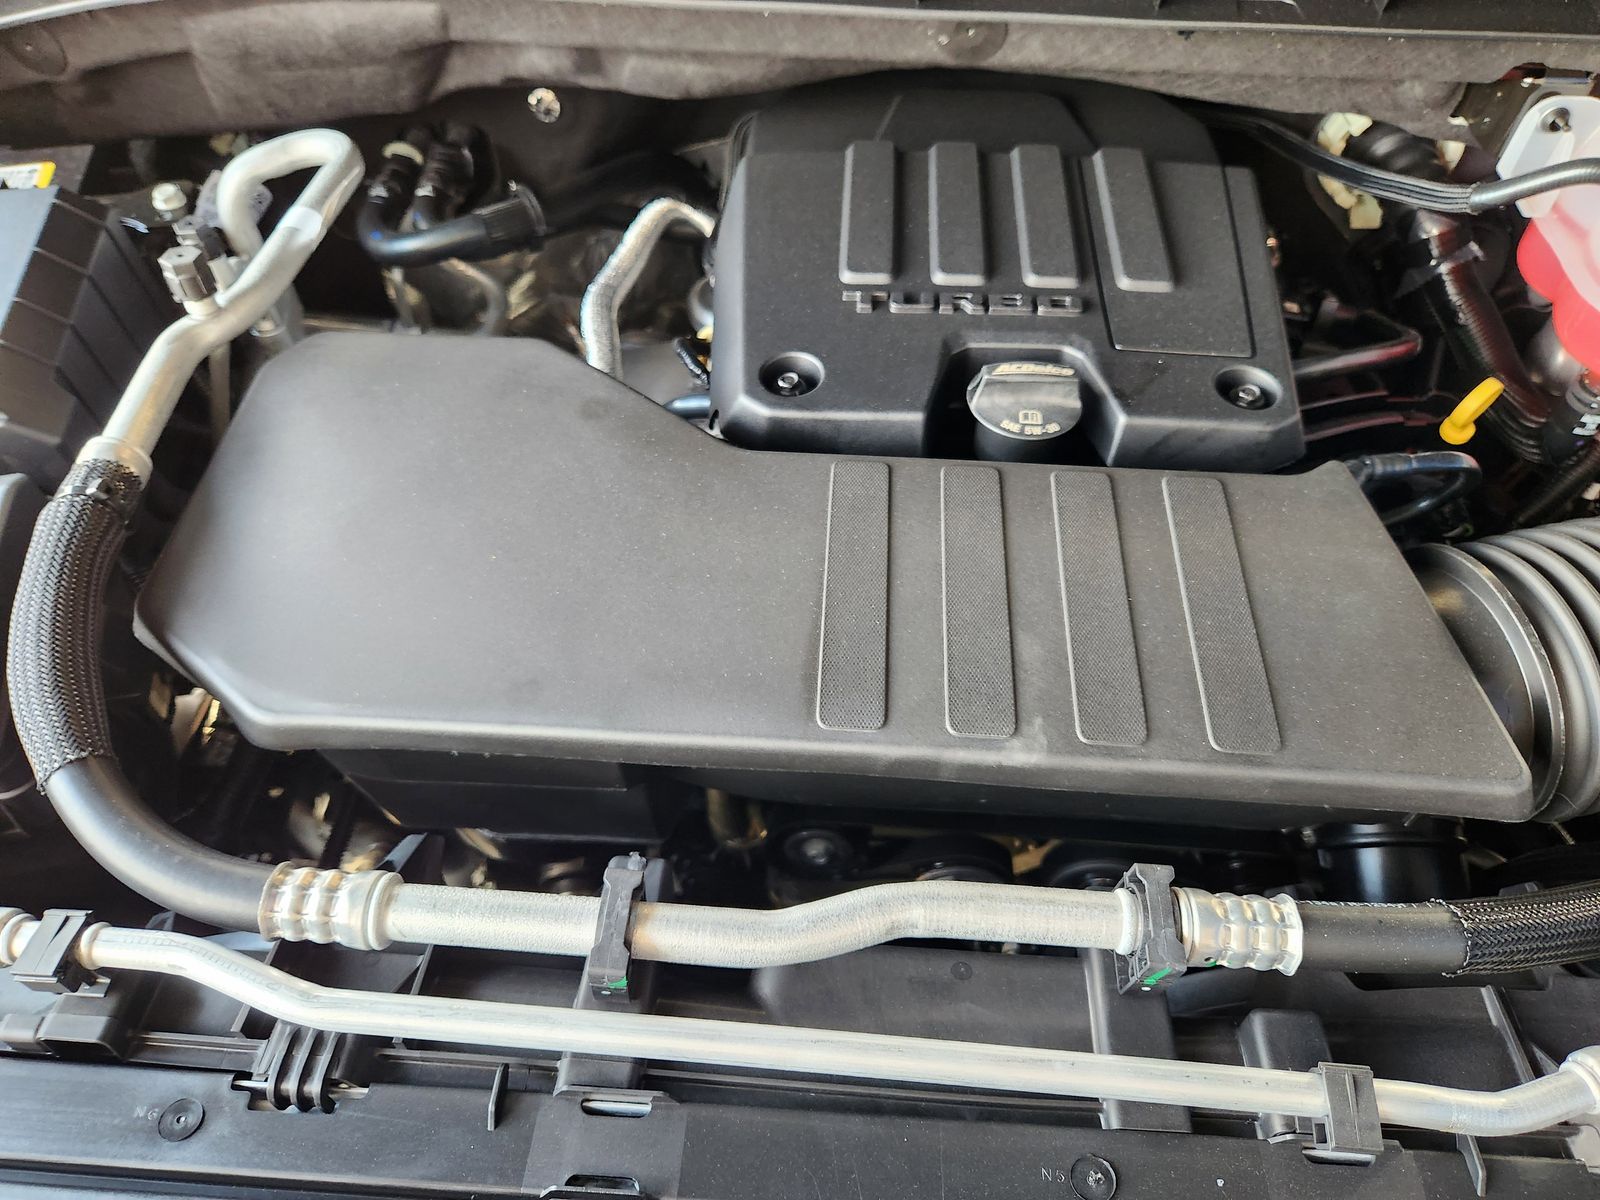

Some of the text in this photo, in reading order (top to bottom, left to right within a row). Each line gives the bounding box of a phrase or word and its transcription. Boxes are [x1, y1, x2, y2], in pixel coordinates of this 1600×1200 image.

[842, 290, 1083, 317] TURBO
[999, 419, 1061, 436] SAE 5W-30
